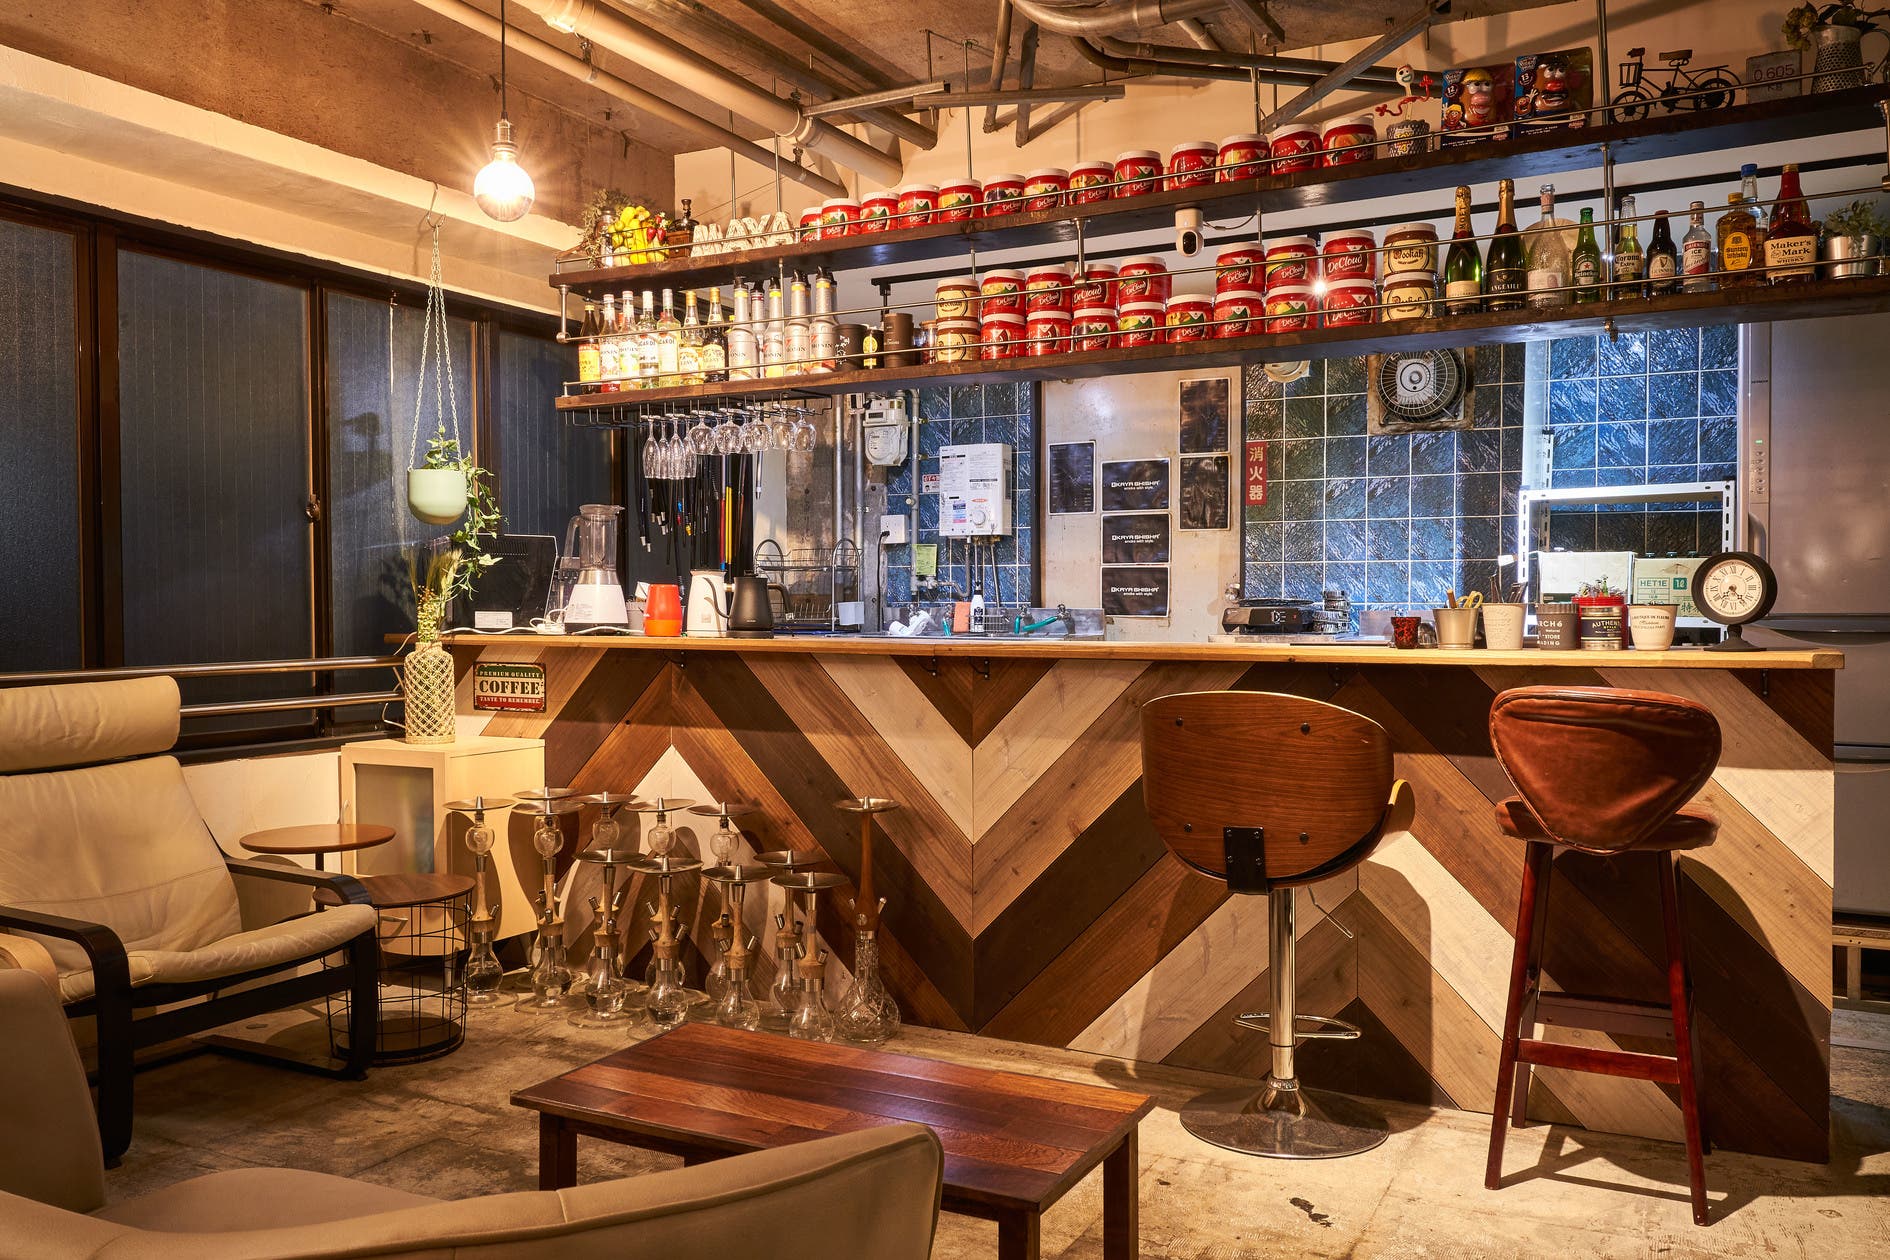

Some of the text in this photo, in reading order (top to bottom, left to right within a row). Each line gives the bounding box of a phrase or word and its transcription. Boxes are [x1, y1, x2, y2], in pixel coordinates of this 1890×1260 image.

[1771, 240, 1812, 250] Maker's
[1782, 247, 1811, 257] Mark
[1328, 254, 1362, 273] DeCloud
[1615, 255, 1640, 264] Corona
[1074, 284, 1101, 303] DeCloud
[1249, 446, 1264, 501] 消火器
[479, 679, 541, 695] COFFEE
